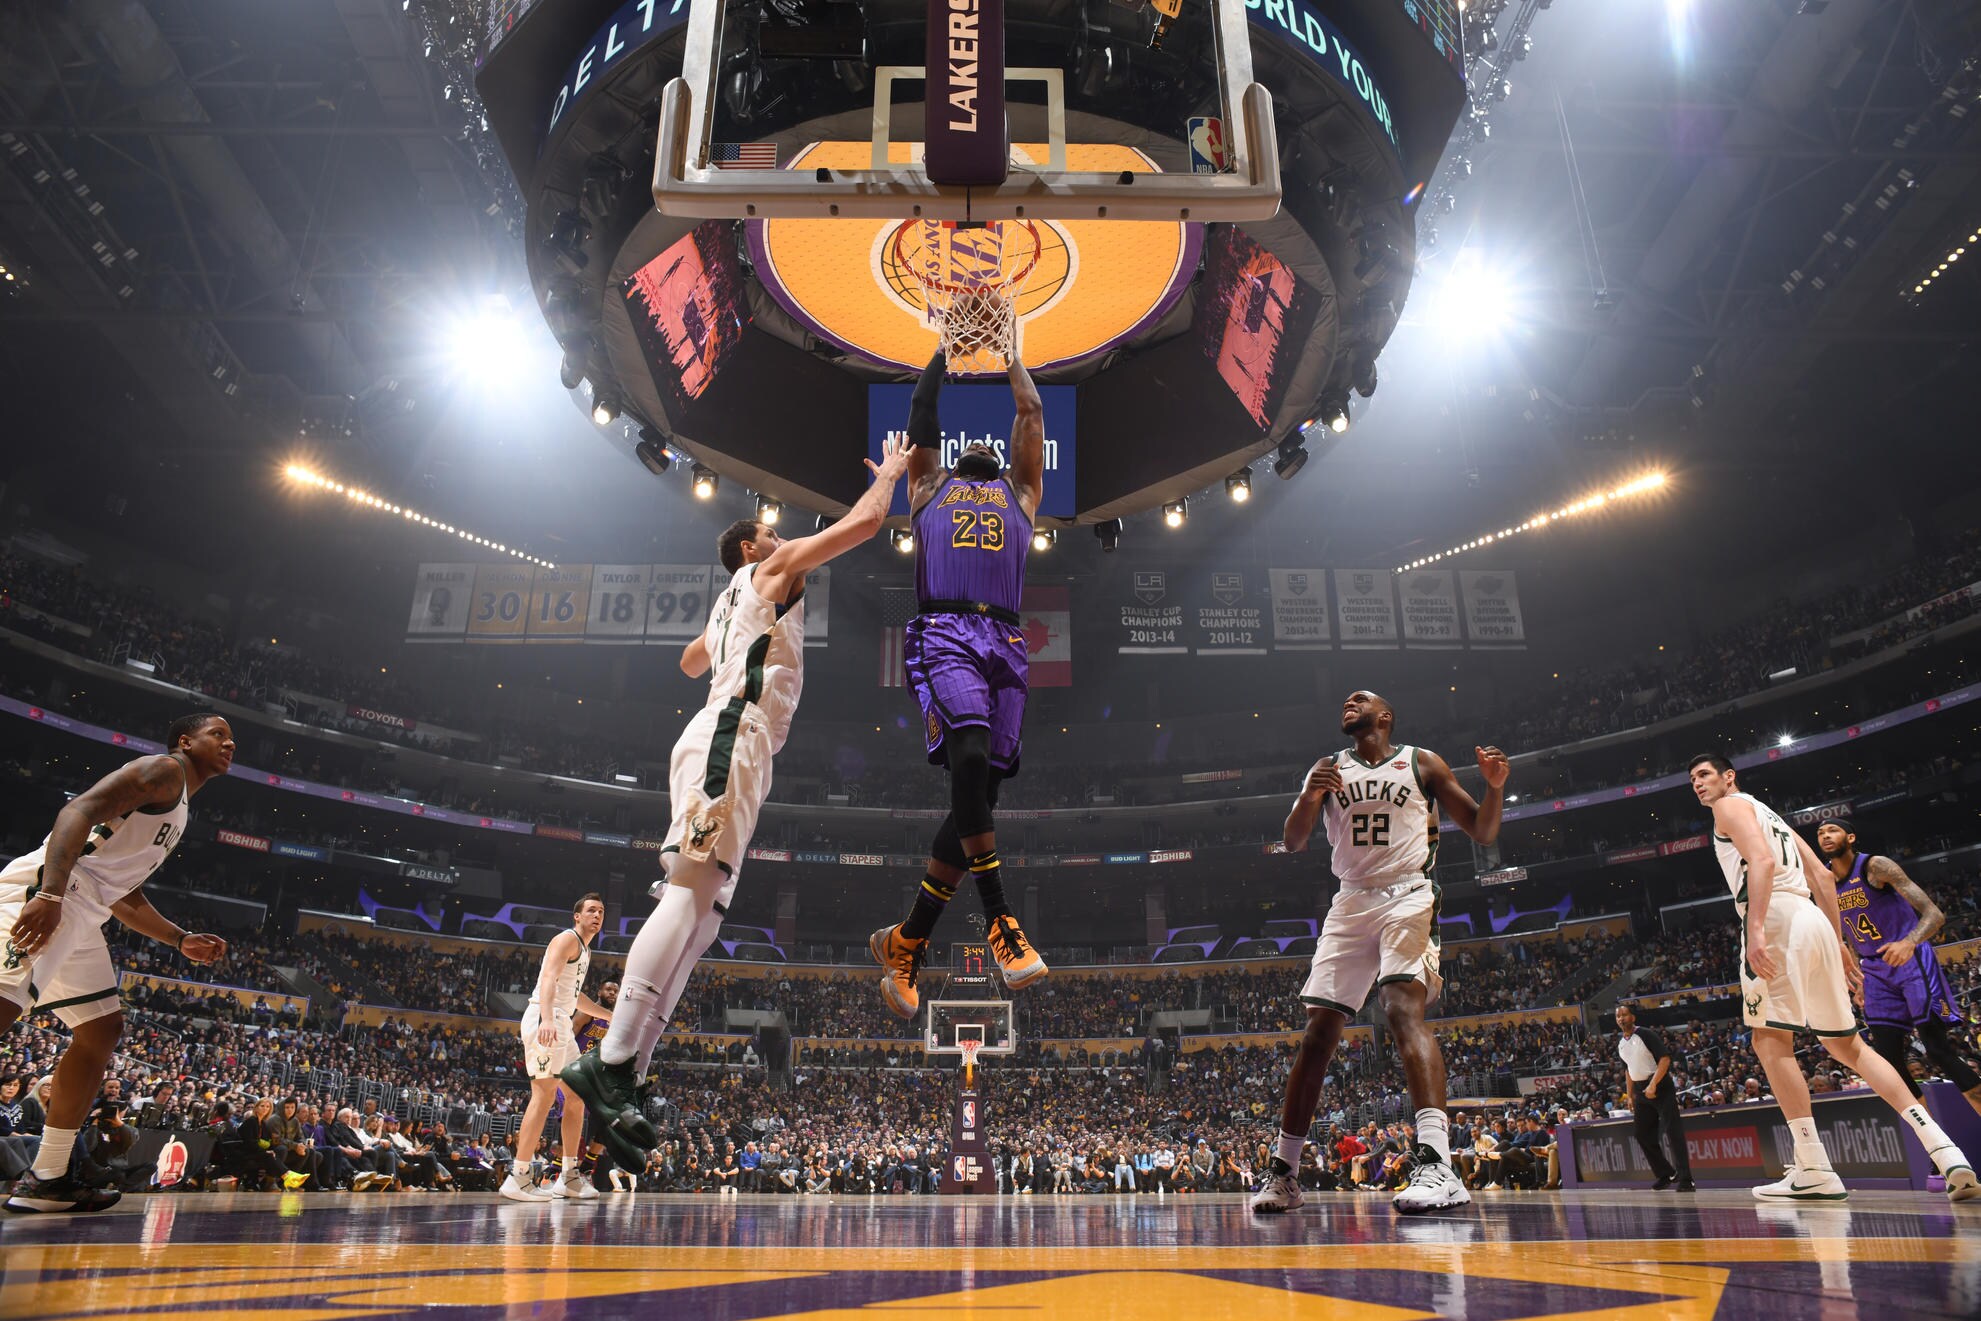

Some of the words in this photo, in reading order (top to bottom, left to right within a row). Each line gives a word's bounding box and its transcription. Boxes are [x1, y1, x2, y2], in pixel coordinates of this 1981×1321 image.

[548, 0, 684, 135] DELT
[1331, 35, 1396, 145] YOUR
[1196, 164, 1214, 175] NBA
[952, 509, 1005, 552] 23
[602, 574, 642, 584] TAYLOR
[656, 574, 705, 584] GRETZKY
[1137, 575, 1163, 587] LA
[1215, 576, 1241, 587] LA
[477, 591, 522, 622] 30
[541, 591, 576, 623] 16
[600, 592, 634, 623] 18
[656, 592, 702, 624] 99
[1121, 607, 1160, 617] STANLEY
[1163, 606, 1182, 616] CUP
[1199, 608, 1239, 618] STANLEY
[1241, 608, 1260, 618] CUP
[1342, 606, 1391, 614] CONFERENCE
[1121, 616, 1183, 627] CHAMPIONS
[1199, 618, 1261, 629] CHAMPIONS
[1279, 616, 1323, 624] CHAMPIONS
[1130, 630, 1175, 643] 2013-14
[1209, 632, 1253, 645] 2011-12
[359, 708, 405, 728] TOYOTA
[1336, 780, 1412, 811] BUCKS
[1793, 803, 1850, 826] TOYOTA
[1352, 813, 1391, 848] 22
[218, 830, 269, 851] TOSHIBA
[645, 841, 661, 849] TOY
[280, 845, 296, 855] BUD
[297, 847, 318, 858] LIGHT
[805, 854, 837, 862] DELTA
[1150, 851, 1192, 862] TOSHIBA
[840, 854, 882, 865] STAPLES
[419, 869, 452, 881] DELTA
[1481, 868, 1527, 885] STAPLES
[1837, 891, 1871, 912] KERS
[1843, 912, 1883, 943] 14
[963, 946, 985, 957] 3:44
[965, 957, 983, 973] 17
[1686, 1139, 1718, 1161] PLAY
[1721, 1136, 1754, 1159] NOW
